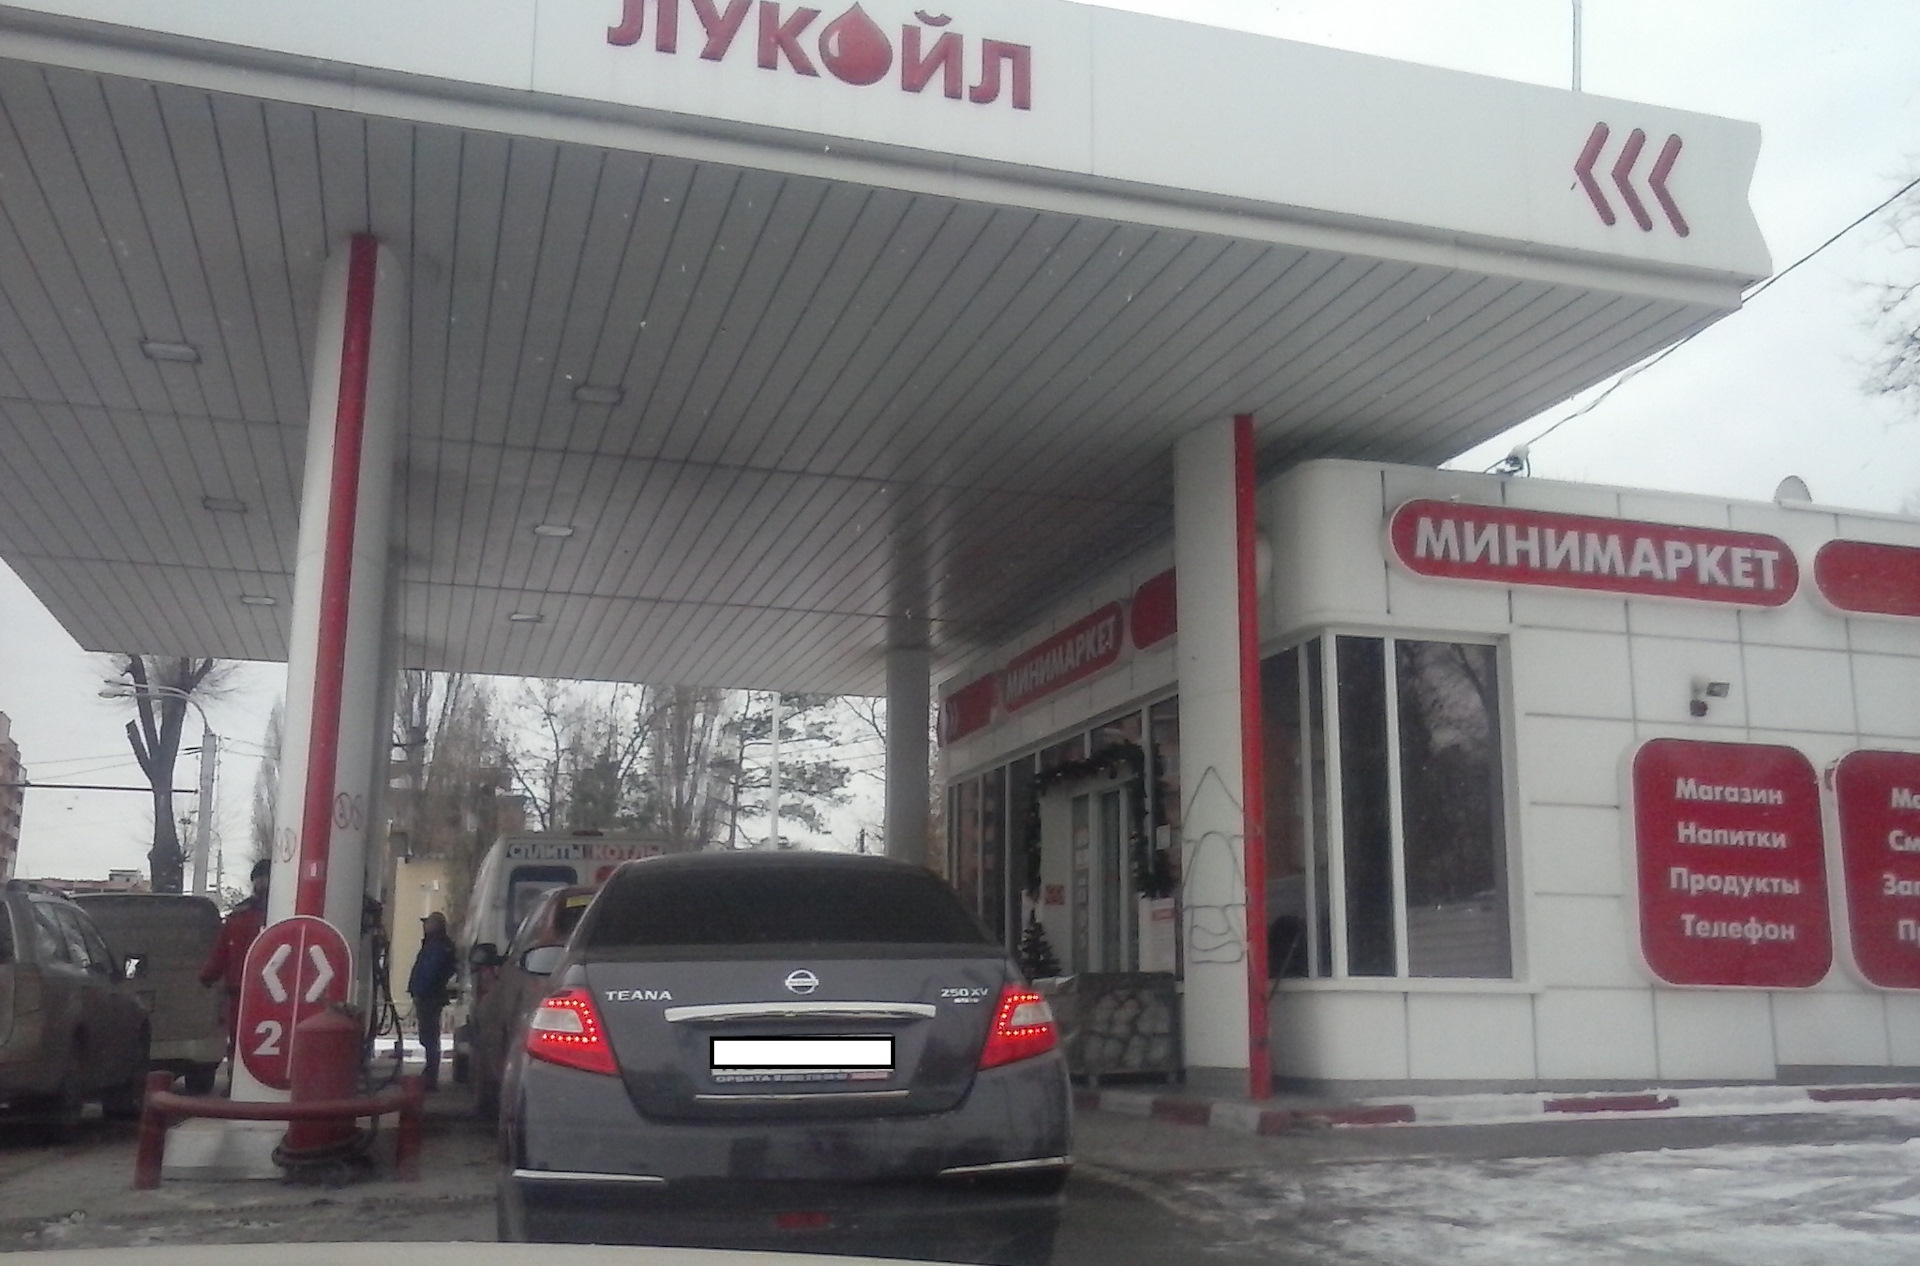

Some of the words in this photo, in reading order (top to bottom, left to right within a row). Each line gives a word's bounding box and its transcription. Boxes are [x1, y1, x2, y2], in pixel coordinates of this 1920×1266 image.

[1415, 516, 1780, 591] МИНИМАРКЕТ
[1005, 614, 1117, 701] МИНИМАРКЕТ
[1675, 778, 1784, 806] Магазин
[1677, 821, 1788, 849] Напитки
[1670, 867, 1801, 898] Продукты
[1681, 914, 1796, 945] Телефон
[605, 989, 674, 1001] TEANA
[941, 988, 969, 998] 250
[971, 987, 989, 997] XV
[253, 1020, 283, 1056] 2
